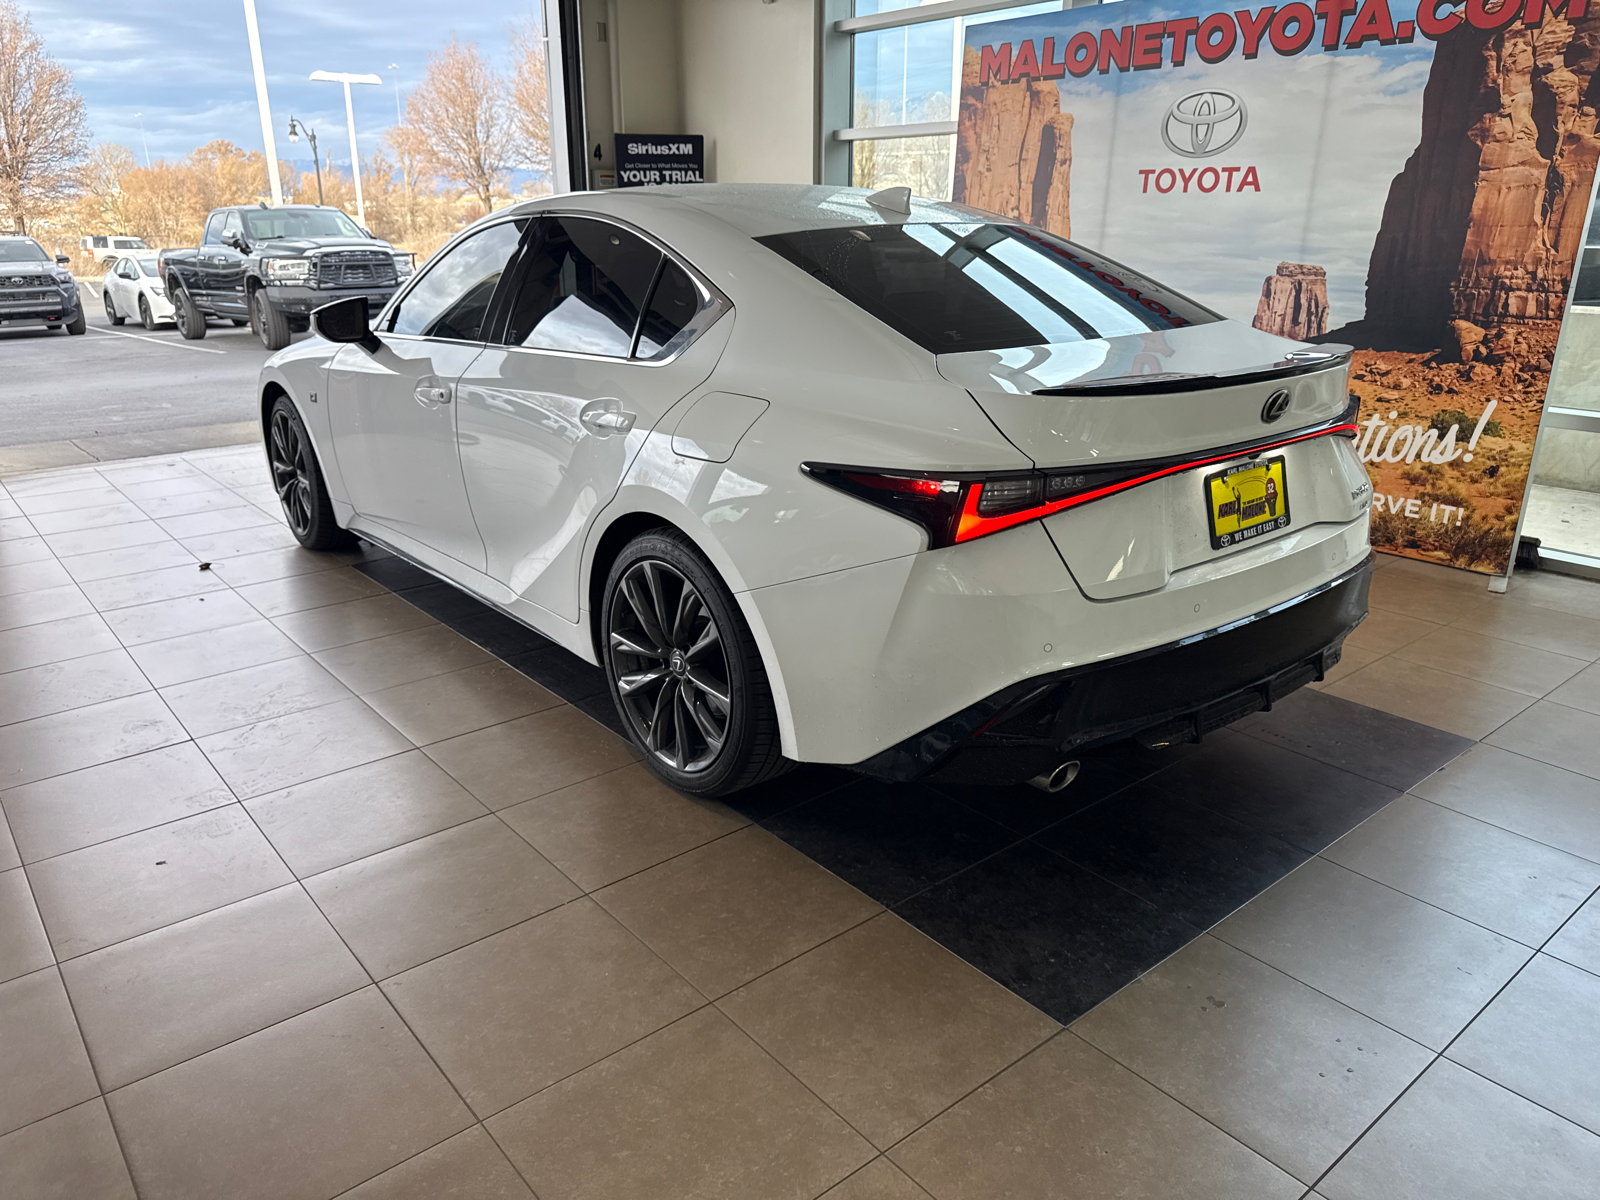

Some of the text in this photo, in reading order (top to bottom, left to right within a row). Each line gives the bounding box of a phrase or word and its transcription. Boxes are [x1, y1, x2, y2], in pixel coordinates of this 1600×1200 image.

[594, 143, 603, 161] 4
[627, 143, 693, 155] SiriusXM
[620, 170, 660, 182] YOUR
[662, 170, 704, 182] TRIAL
[1138, 165, 1262, 194] TOYOTA
[1267, 483, 1275, 494] 32
[1218, 500, 1238, 520] KARL
[1429, 503, 1465, 527] IT!
[1234, 521, 1275, 542] WE MAKE IT EASY
